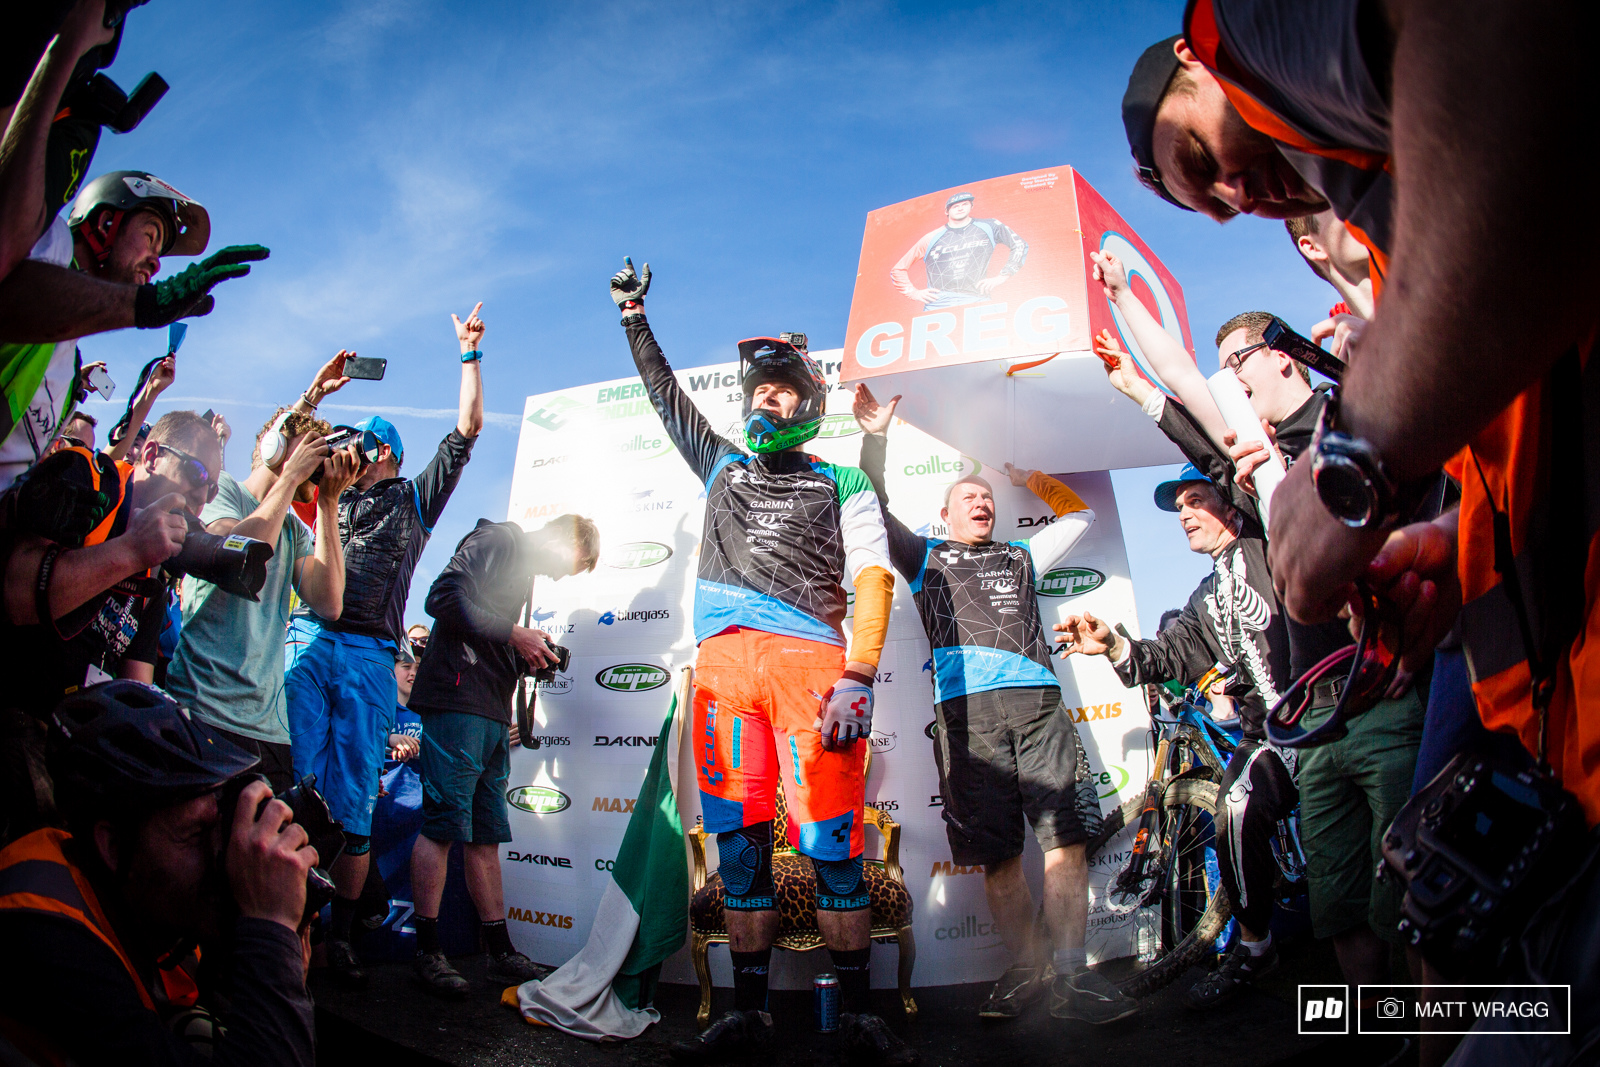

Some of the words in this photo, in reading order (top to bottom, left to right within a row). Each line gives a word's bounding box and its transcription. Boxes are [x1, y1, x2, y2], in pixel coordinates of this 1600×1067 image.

[855, 295, 1070, 369] GREG
[688, 371, 743, 392] Wic
[775, 433, 810, 450] GARMIN
[750, 499, 794, 510] GARMIN
[746, 511, 792, 530] FOX
[981, 577, 1020, 594] FOX
[617, 609, 670, 623] bluegrass
[603, 669, 664, 690] hope
[705, 699, 718, 766] CUBE
[513, 792, 564, 813] hope
[506, 850, 573, 869] DAKINE
[508, 906, 573, 930] MAXXIS
